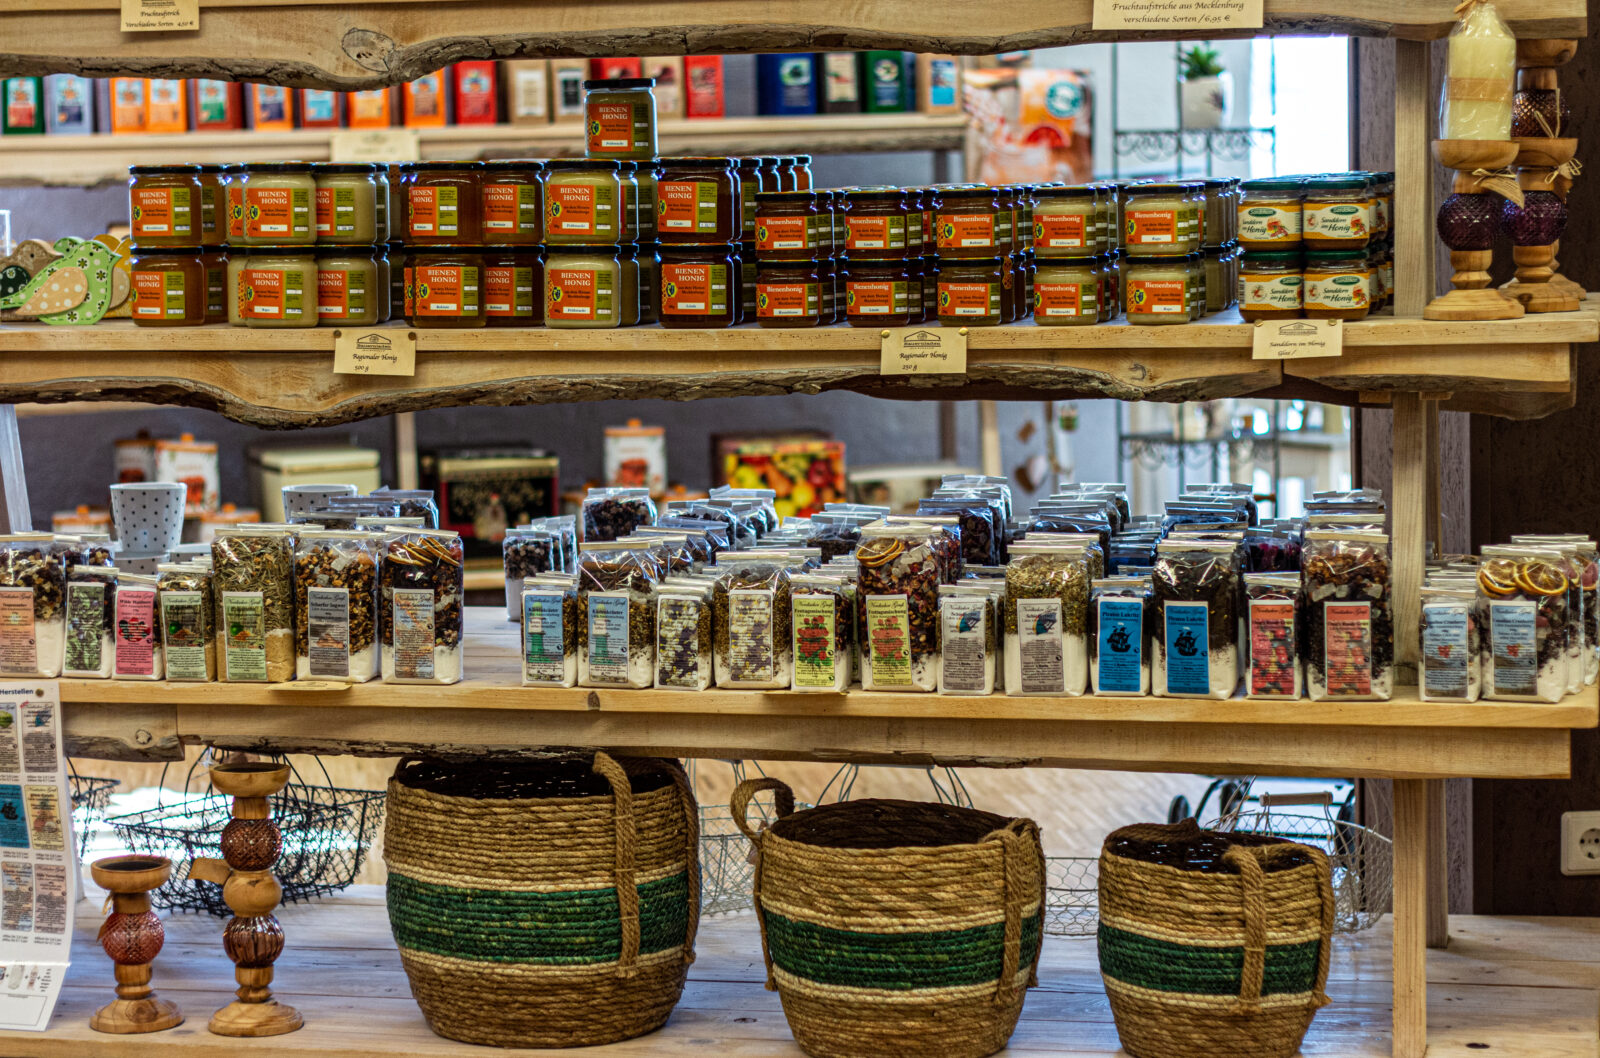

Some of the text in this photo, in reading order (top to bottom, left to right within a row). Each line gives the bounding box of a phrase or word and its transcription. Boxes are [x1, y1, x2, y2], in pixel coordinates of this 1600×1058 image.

[1112, 1, 1177, 12] Fruchtaufstriche
[1195, 0, 1244, 11] Mecklenburg
[1124, 15, 1170, 23] verschiedene
[766, 218, 802, 226] Bienenhonig
[1042, 215, 1080, 223] Bienenhonig
[1246, 225, 1267, 236] Honig
[1328, 224, 1351, 233] Honig
[767, 286, 803, 294] Bienenhonig
[949, 284, 986, 292] Bienenhonig
[1278, 295, 1297, 303] Honig
[1330, 295, 1353, 304] Honig
[352, 353, 398, 363] Regionaler Honig
[900, 351, 947, 360] Regionaler Honig
